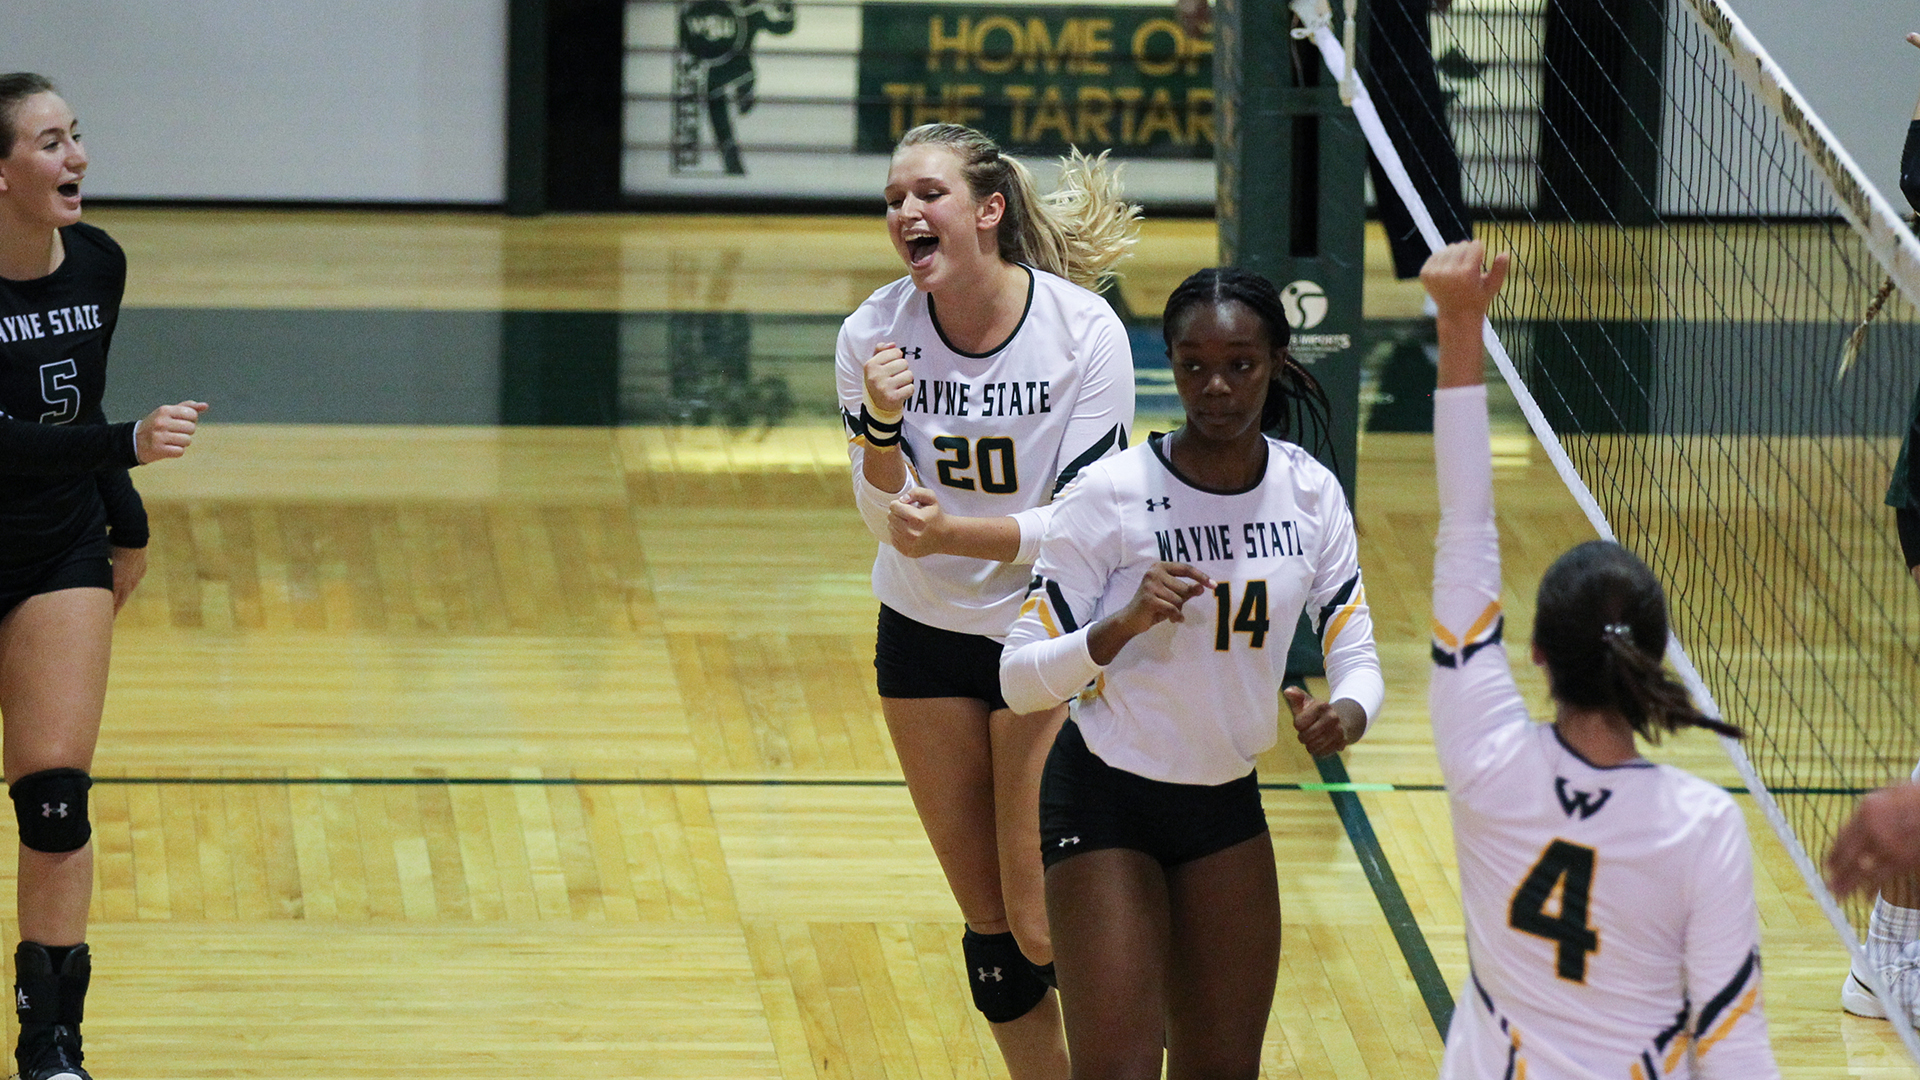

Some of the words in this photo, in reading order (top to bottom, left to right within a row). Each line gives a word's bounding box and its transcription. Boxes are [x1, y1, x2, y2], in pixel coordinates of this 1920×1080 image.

[927, 15, 1114, 76] HOME
[1131, 19, 1216, 76] OF
[881, 83, 985, 140] THE
[48, 304, 103, 336] STATE
[39, 358, 81, 426] 5
[982, 381, 1051, 417] STATE
[932, 435, 1019, 495] 20
[1155, 525, 1234, 563] WAYNE
[1212, 579, 1270, 652] 14
[1506, 836, 1601, 985] 4
